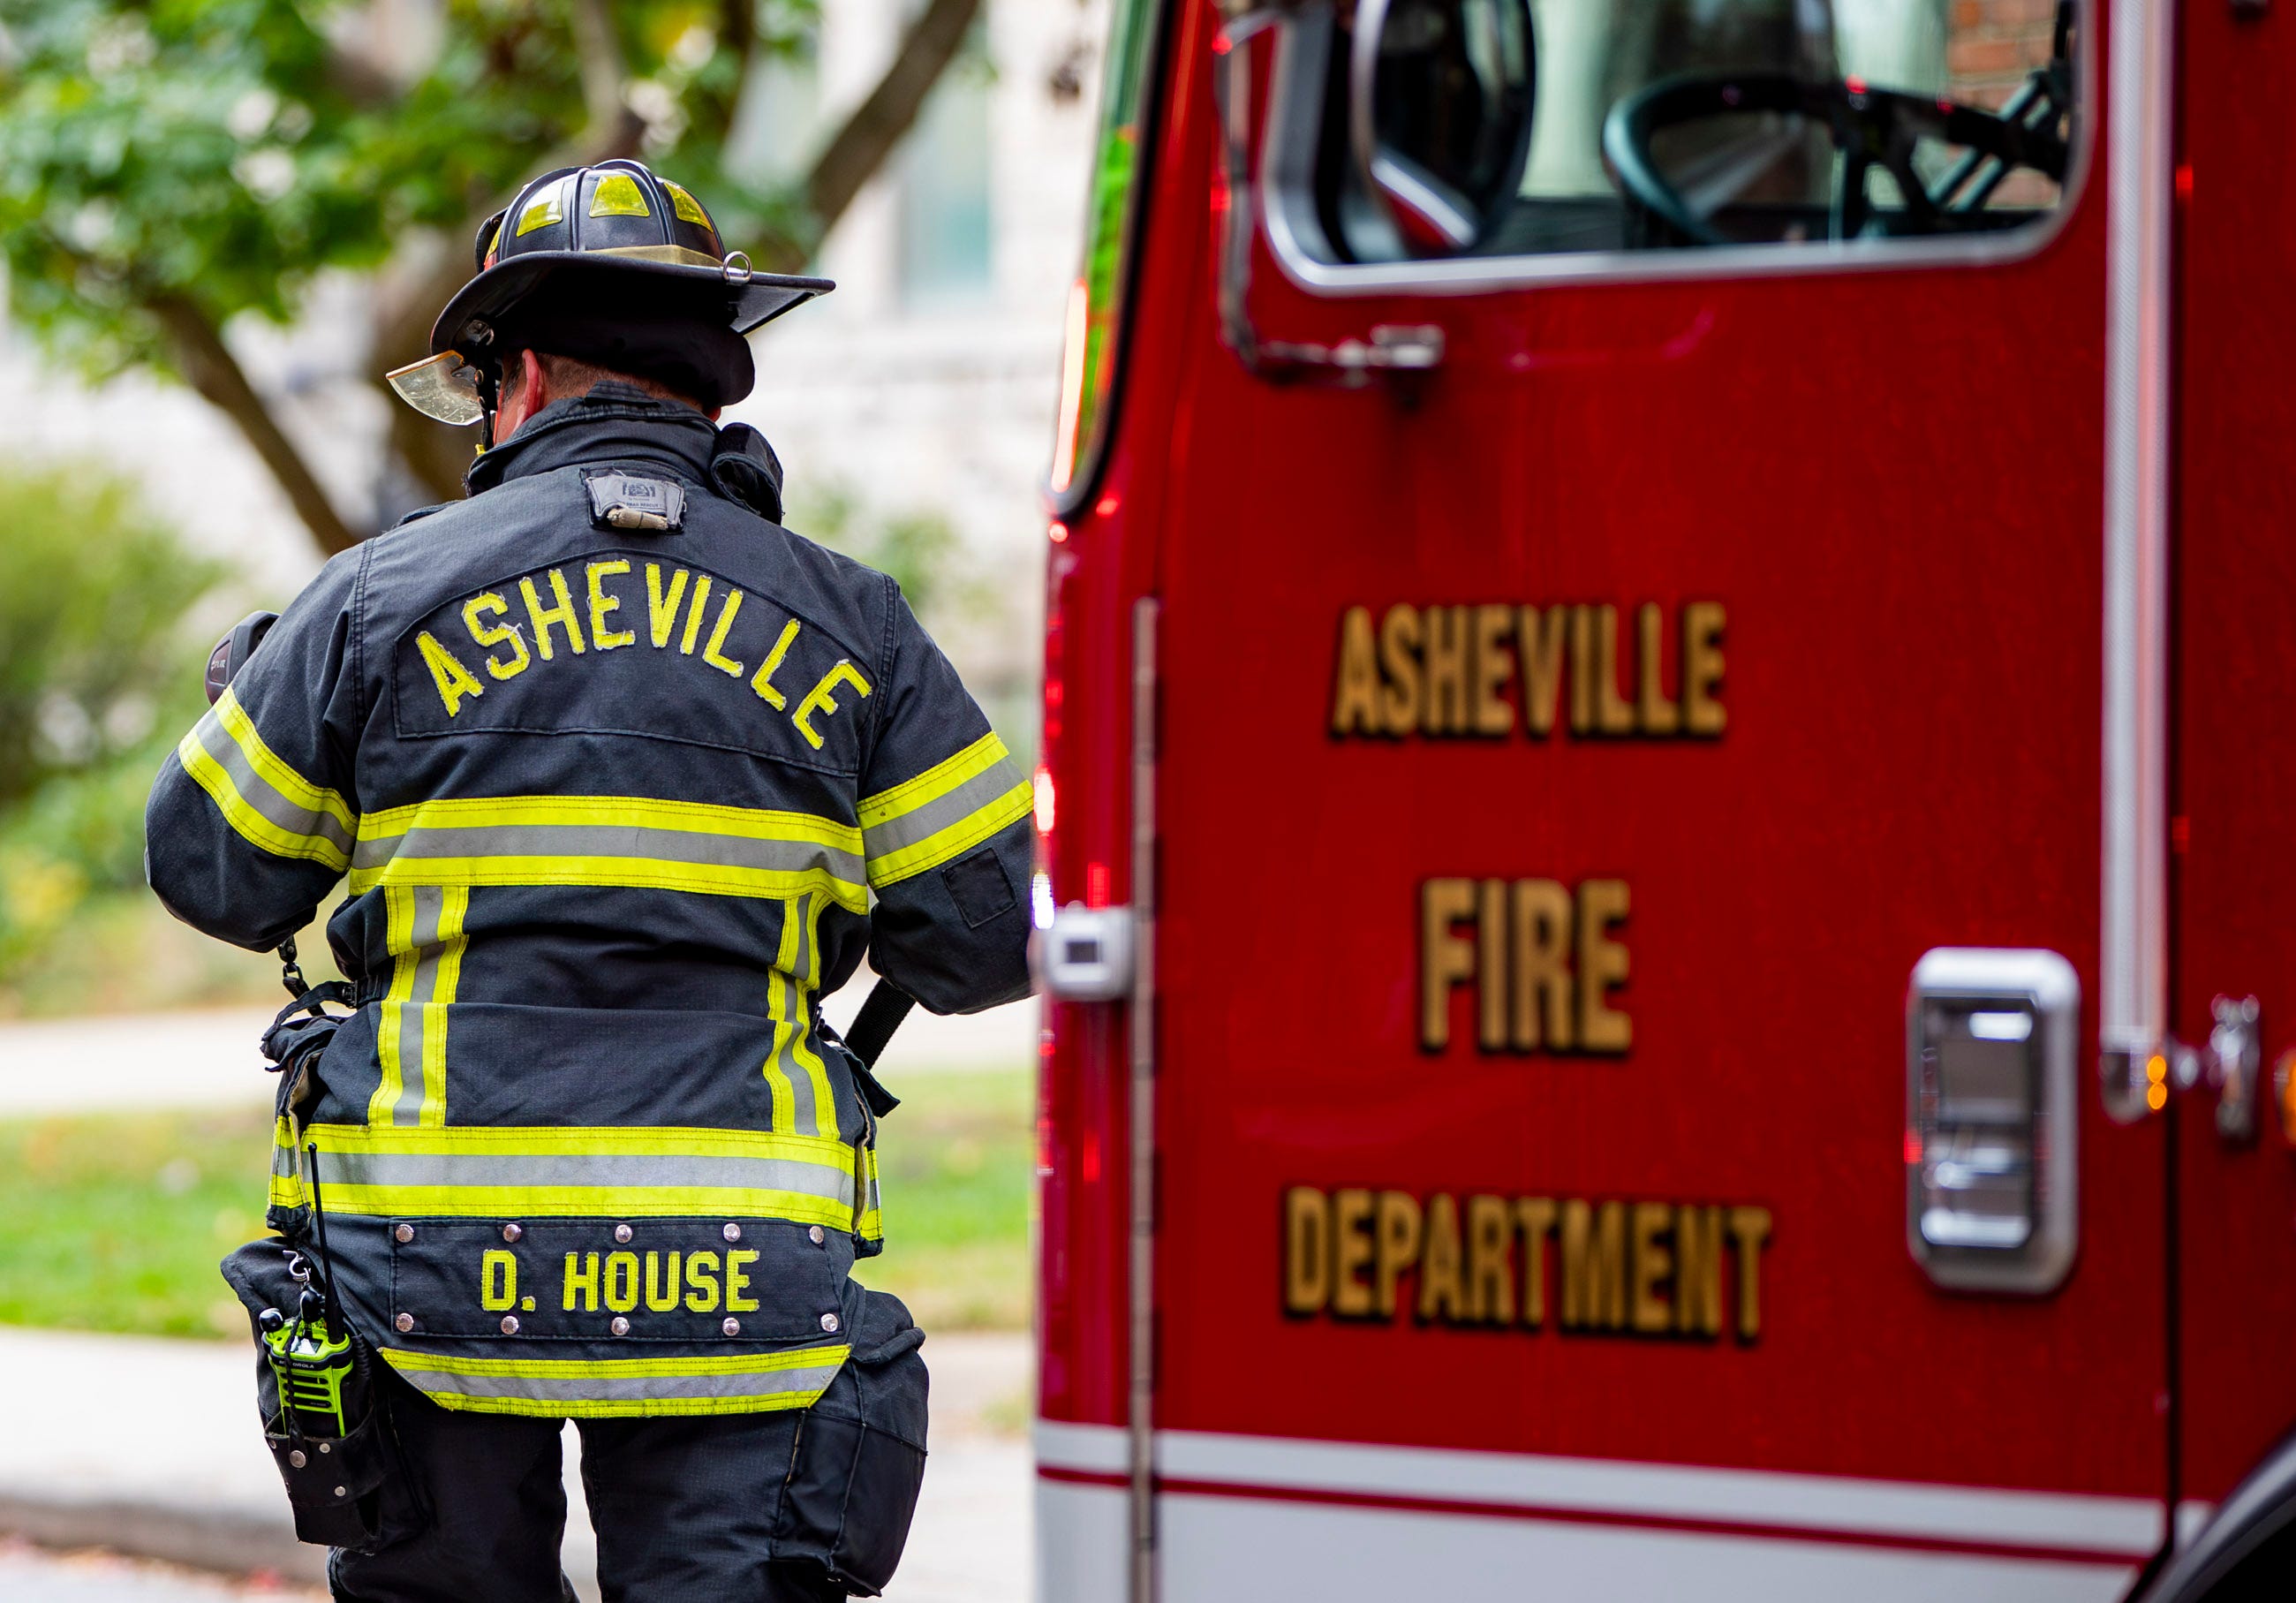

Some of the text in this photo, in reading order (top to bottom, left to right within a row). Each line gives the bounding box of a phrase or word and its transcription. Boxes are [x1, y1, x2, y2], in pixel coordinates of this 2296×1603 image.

[415, 559, 872, 750] ASHEVILLE
[1332, 602, 1727, 737] ASHEVILLE
[1421, 878, 1633, 1055] FIRE
[481, 1249, 760, 1313] D. HOUSE
[1285, 1186, 1771, 1341] DEPARTMENT
[279, 1360, 314, 1369] MOROLA
